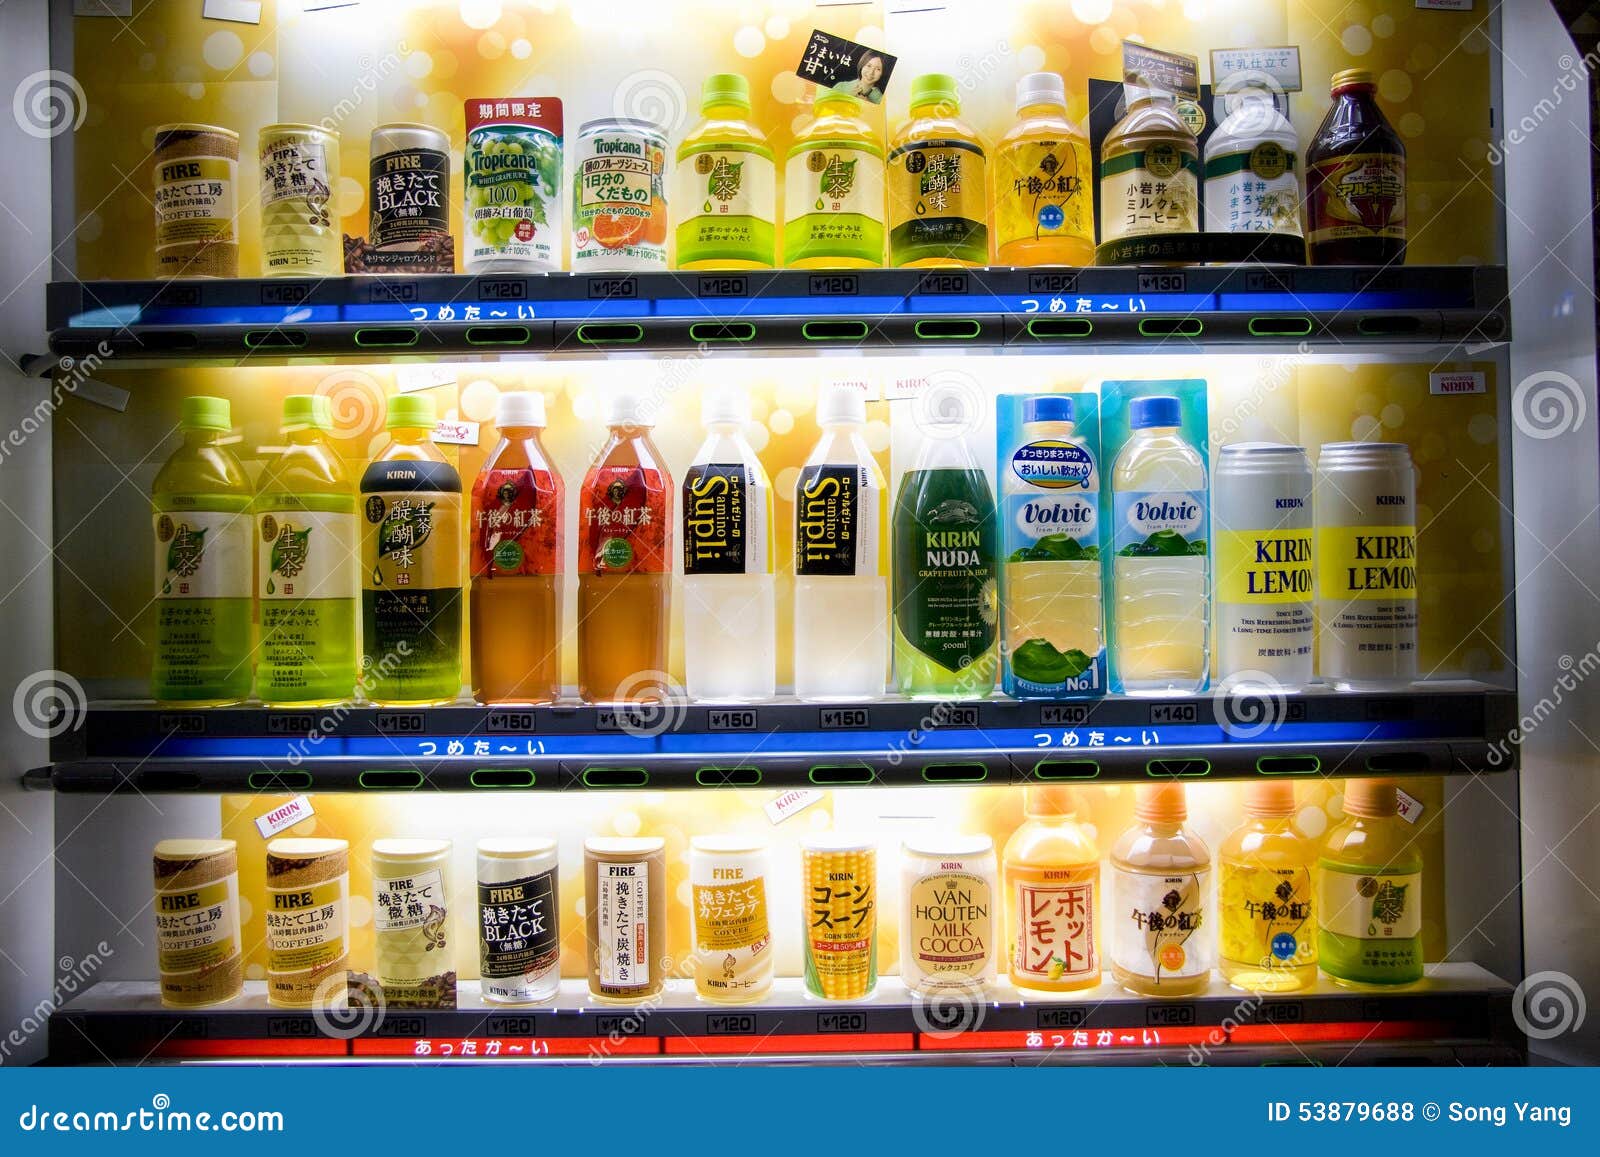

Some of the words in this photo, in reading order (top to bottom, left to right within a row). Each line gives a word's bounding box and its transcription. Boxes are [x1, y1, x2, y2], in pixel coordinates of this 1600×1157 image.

[810, 43, 852, 67] うまいは
[1223, 57, 1288, 70] 牛乳仕立て
[479, 103, 542, 119] 期間限定
[594, 138, 641, 155] Tropicana
[386, 155, 421, 171] FIRE
[472, 149, 537, 173] Tropicana
[162, 163, 201, 181] FIRE
[713, 156, 738, 202] 生茶
[826, 155, 849, 199] 生茶
[377, 173, 438, 195] 挽きたて
[584, 173, 625, 189] 1日分の
[927, 153, 948, 211] 醍醐味
[1230, 181, 1267, 194] 小岩井
[488, 186, 517, 204] 100
[595, 188, 648, 202] くだもの
[1127, 182, 1167, 196] 小岩井
[378, 191, 440, 212] BLACK
[1127, 198, 1179, 210] ミルクと
[1230, 195, 1278, 207] まろやか
[164, 209, 211, 221] COFFEE
[1127, 212, 1178, 224] コーヒー
[1231, 207, 1283, 220] ヨーグルト
[269, 257, 288, 266] KIRIN
[593, 281, 633, 296] ¥120
[704, 280, 743, 294] ¥120
[814, 279, 854, 292] ¥120
[925, 278, 963, 291] ¥120
[1034, 277, 1073, 290] ¥120
[1142, 276, 1181, 289] ¥130
[483, 283, 522, 298] ¥120
[1020, 448, 1080, 460] すっきりまろやか
[386, 470, 416, 481] KIRIN
[1021, 463, 1081, 477] おいしい軟水
[1275, 498, 1303, 509] KIRIN
[1376, 495, 1405, 505] KIRIN
[415, 501, 433, 534] 生茶
[584, 506, 652, 527] 午後の紅茶
[688, 475, 729, 560] Supli
[716, 496, 729, 537] amino
[1024, 502, 1091, 523] Volvic
[1135, 501, 1198, 520] Volvic
[475, 509, 543, 529] 午後の紅茶
[799, 477, 840, 562] Supli
[827, 498, 840, 539] amino
[391, 499, 414, 569] 醍醐味
[926, 531, 980, 549] KIRIN
[174, 523, 203, 577] 生茶
[277, 523, 307, 577] 生茶
[1255, 537, 1312, 563] KIRIN
[1355, 535, 1416, 560] KIRIN
[926, 550, 980, 567] NUDA
[942, 639, 967, 651] 500ml
[1066, 656, 1099, 691] No.1
[491, 714, 532, 729] ¥150
[600, 713, 641, 728] ¥150
[712, 712, 753, 727] ¥150
[825, 711, 865, 725] ¥150
[1044, 709, 1084, 723] ¥140
[1154, 707, 1194, 721] ¥140
[380, 715, 421, 730] ¥150
[266, 801, 301, 825] KIRIN
[609, 866, 636, 877] FIRE
[940, 862, 963, 870] KIRIN
[713, 868, 744, 880] FIRE
[828, 871, 854, 881] KIRIN
[1044, 871, 1070, 880] KIRIN
[389, 879, 414, 891] FIRE
[161, 892, 200, 910] FIRE
[274, 891, 314, 909] FIRE
[378, 886, 432, 907] 挽きたて
[490, 886, 525, 903] FIRE
[698, 885, 756, 905] 挽きたて
[812, 884, 870, 905] コーン
[933, 889, 971, 904] VAN
[388, 903, 424, 920] 微糖
[483, 900, 543, 924] 挽きたて
[699, 900, 760, 920] カフェラテ
[812, 902, 873, 929] スープ
[916, 905, 987, 921] HOUTEN
[485, 916, 547, 941] BLACK
[615, 880, 631, 981] 挽きたて炭焼き
[824, 932, 843, 940] CORN
[931, 922, 973, 937] MILK
[1030, 890, 1056, 972] レモン
[1056, 889, 1084, 972] ホット
[164, 936, 212, 950] COFFEE
[275, 935, 324, 949] COFFEE
[919, 937, 984, 953] COCOA
[932, 962, 974, 972] ミルクココア
[600, 987, 622, 995] KIRIN
[707, 979, 728, 989] KIRIN
[730, 979, 757, 989] コーヒー
[822, 1015, 862, 1029] ¥120
[1042, 1012, 1081, 1025] ¥120
[1152, 1009, 1190, 1023] ¥120
[493, 1019, 530, 1033] ¥120
[712, 1017, 752, 1031] ¥120
